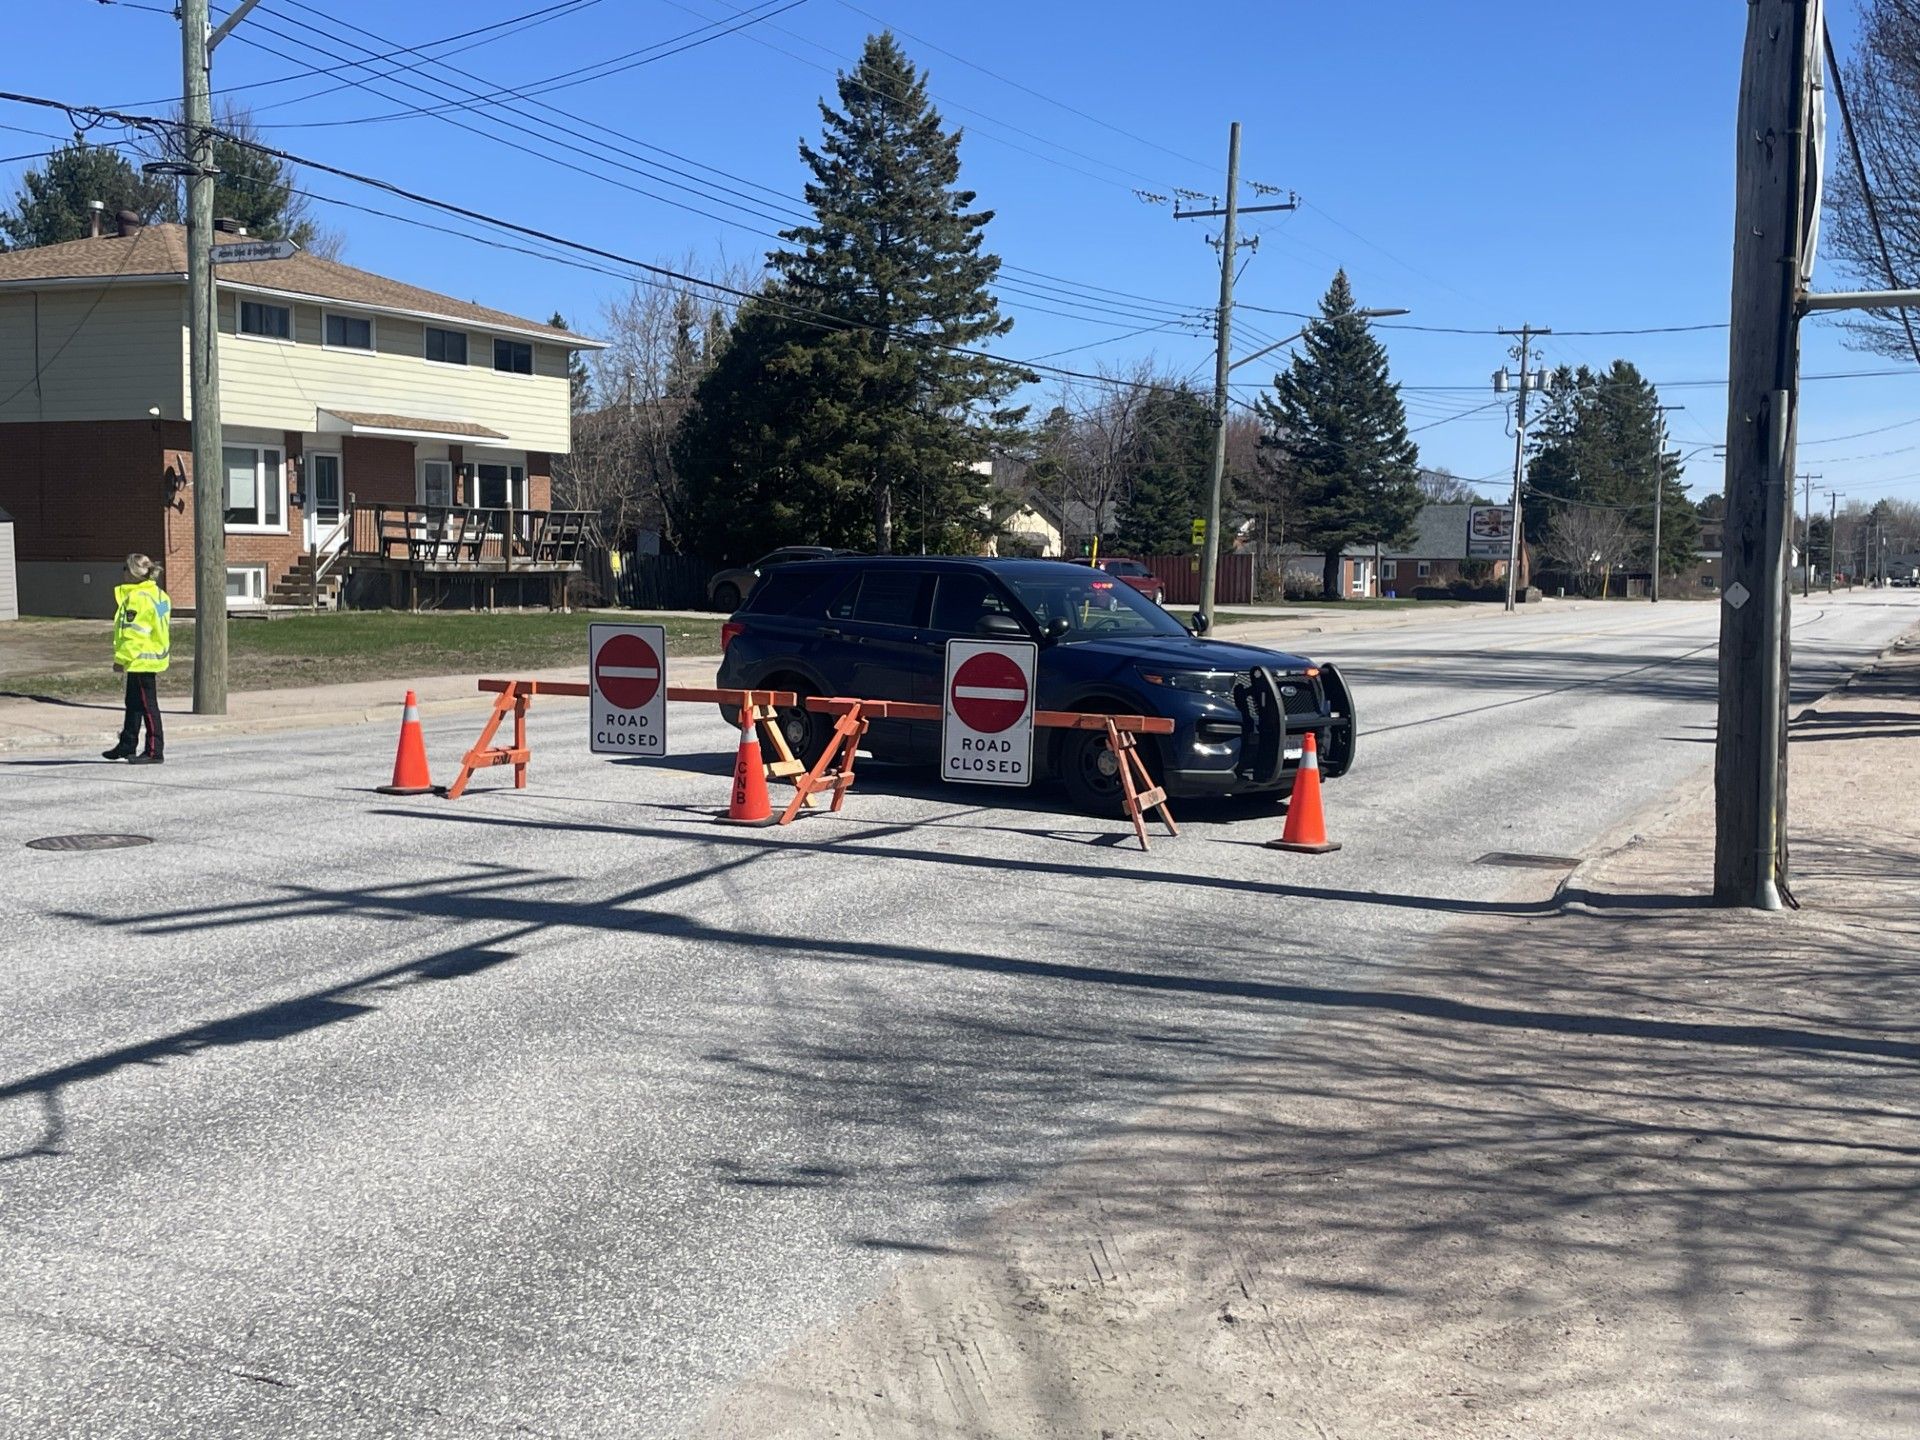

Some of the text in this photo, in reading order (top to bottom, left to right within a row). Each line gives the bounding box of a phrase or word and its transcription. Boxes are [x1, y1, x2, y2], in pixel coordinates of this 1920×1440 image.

[606, 713, 649, 728] ROAD
[597, 731, 658, 747] CLOSED
[962, 738, 1011, 753] ROAD
[950, 757, 1022, 774] CLOSED
[736, 761, 748, 805] CNB
